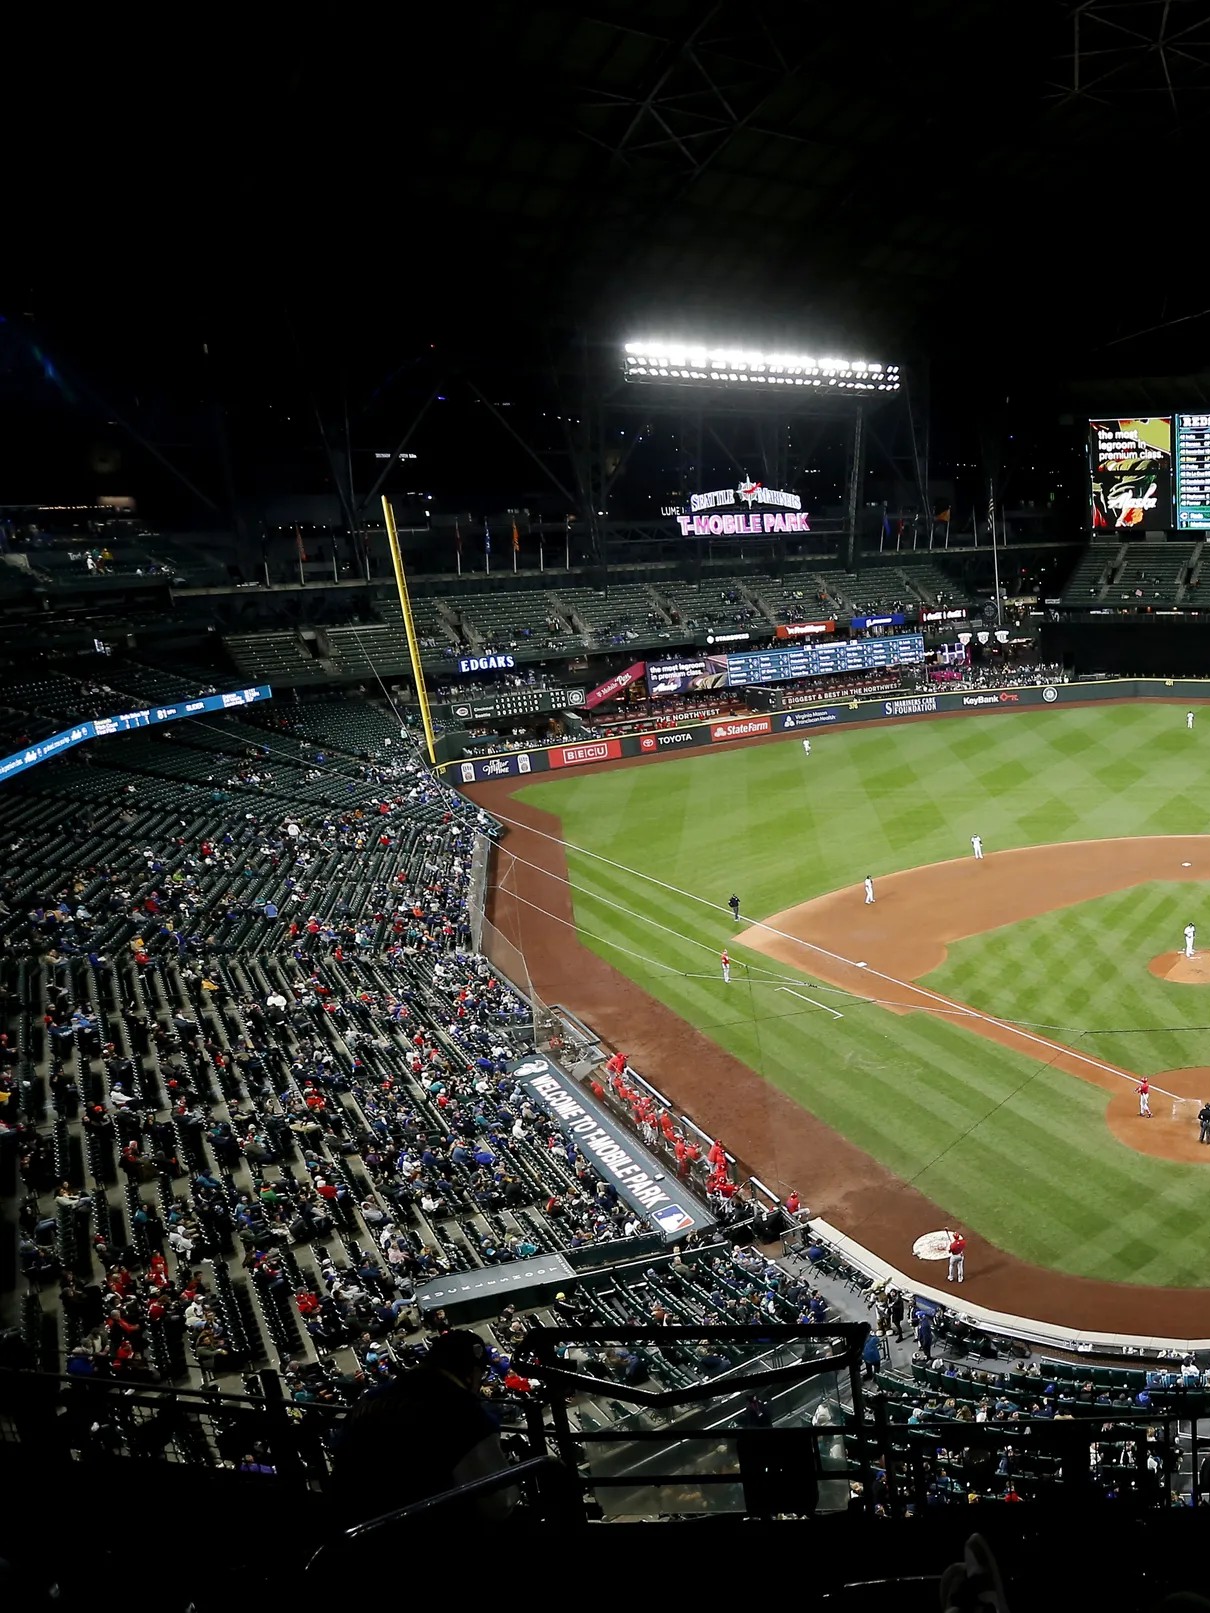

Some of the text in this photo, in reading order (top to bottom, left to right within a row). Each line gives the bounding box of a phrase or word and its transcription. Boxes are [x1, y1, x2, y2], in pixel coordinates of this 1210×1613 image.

[1098, 430, 1138, 439] the most
[1099, 440, 1146, 451] legroom in
[1099, 450, 1163, 462] premium class.
[677, 512, 810, 536] T-MOBILE PARK
[460, 656, 515, 672] EDGARS
[650, 661, 705, 674] the most legroom
[659, 671, 685, 681] premium
[686, 668, 704, 677] class.
[601, 683, 618, 696] Mobile
[788, 695, 816, 704] BIGGEST
[849, 687, 862, 695] THE
[864, 683, 902, 693] NORTHWEST
[886, 702, 893, 715] S
[894, 699, 921, 707] MARINERS
[963, 695, 999, 706] KeyBank
[157, 709, 167, 719] 81
[186, 702, 204, 711] SLIDER
[672, 709, 720, 721] NORTHWEST
[894, 703, 937, 714] FOUNDATION
[726, 722, 768, 736] StateFarm
[658, 733, 693, 745] TOYOTA
[529, 1073, 672, 1209] WELCOME TO T-MOBILE PARK
[421, 1265, 558, 1301] MUCKLESHOOT
